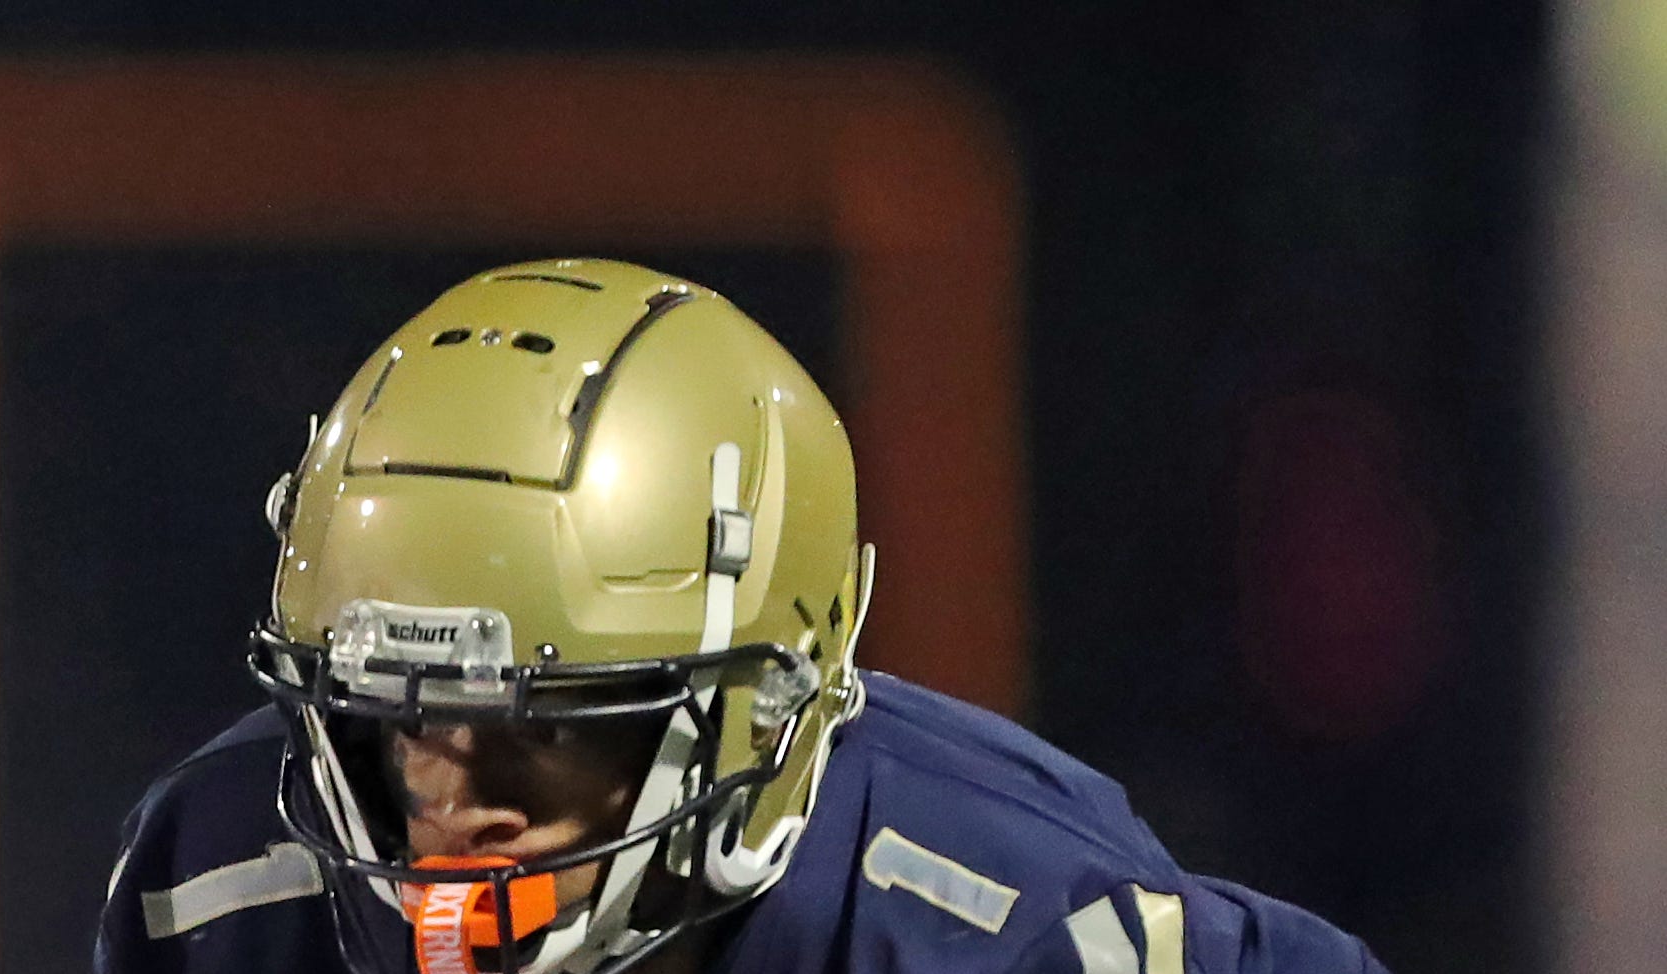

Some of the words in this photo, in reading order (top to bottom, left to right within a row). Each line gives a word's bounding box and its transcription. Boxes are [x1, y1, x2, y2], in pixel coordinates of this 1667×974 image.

[388, 619, 459, 643] schutt
[141, 841, 325, 940] 1
[862, 826, 1020, 934] 1
